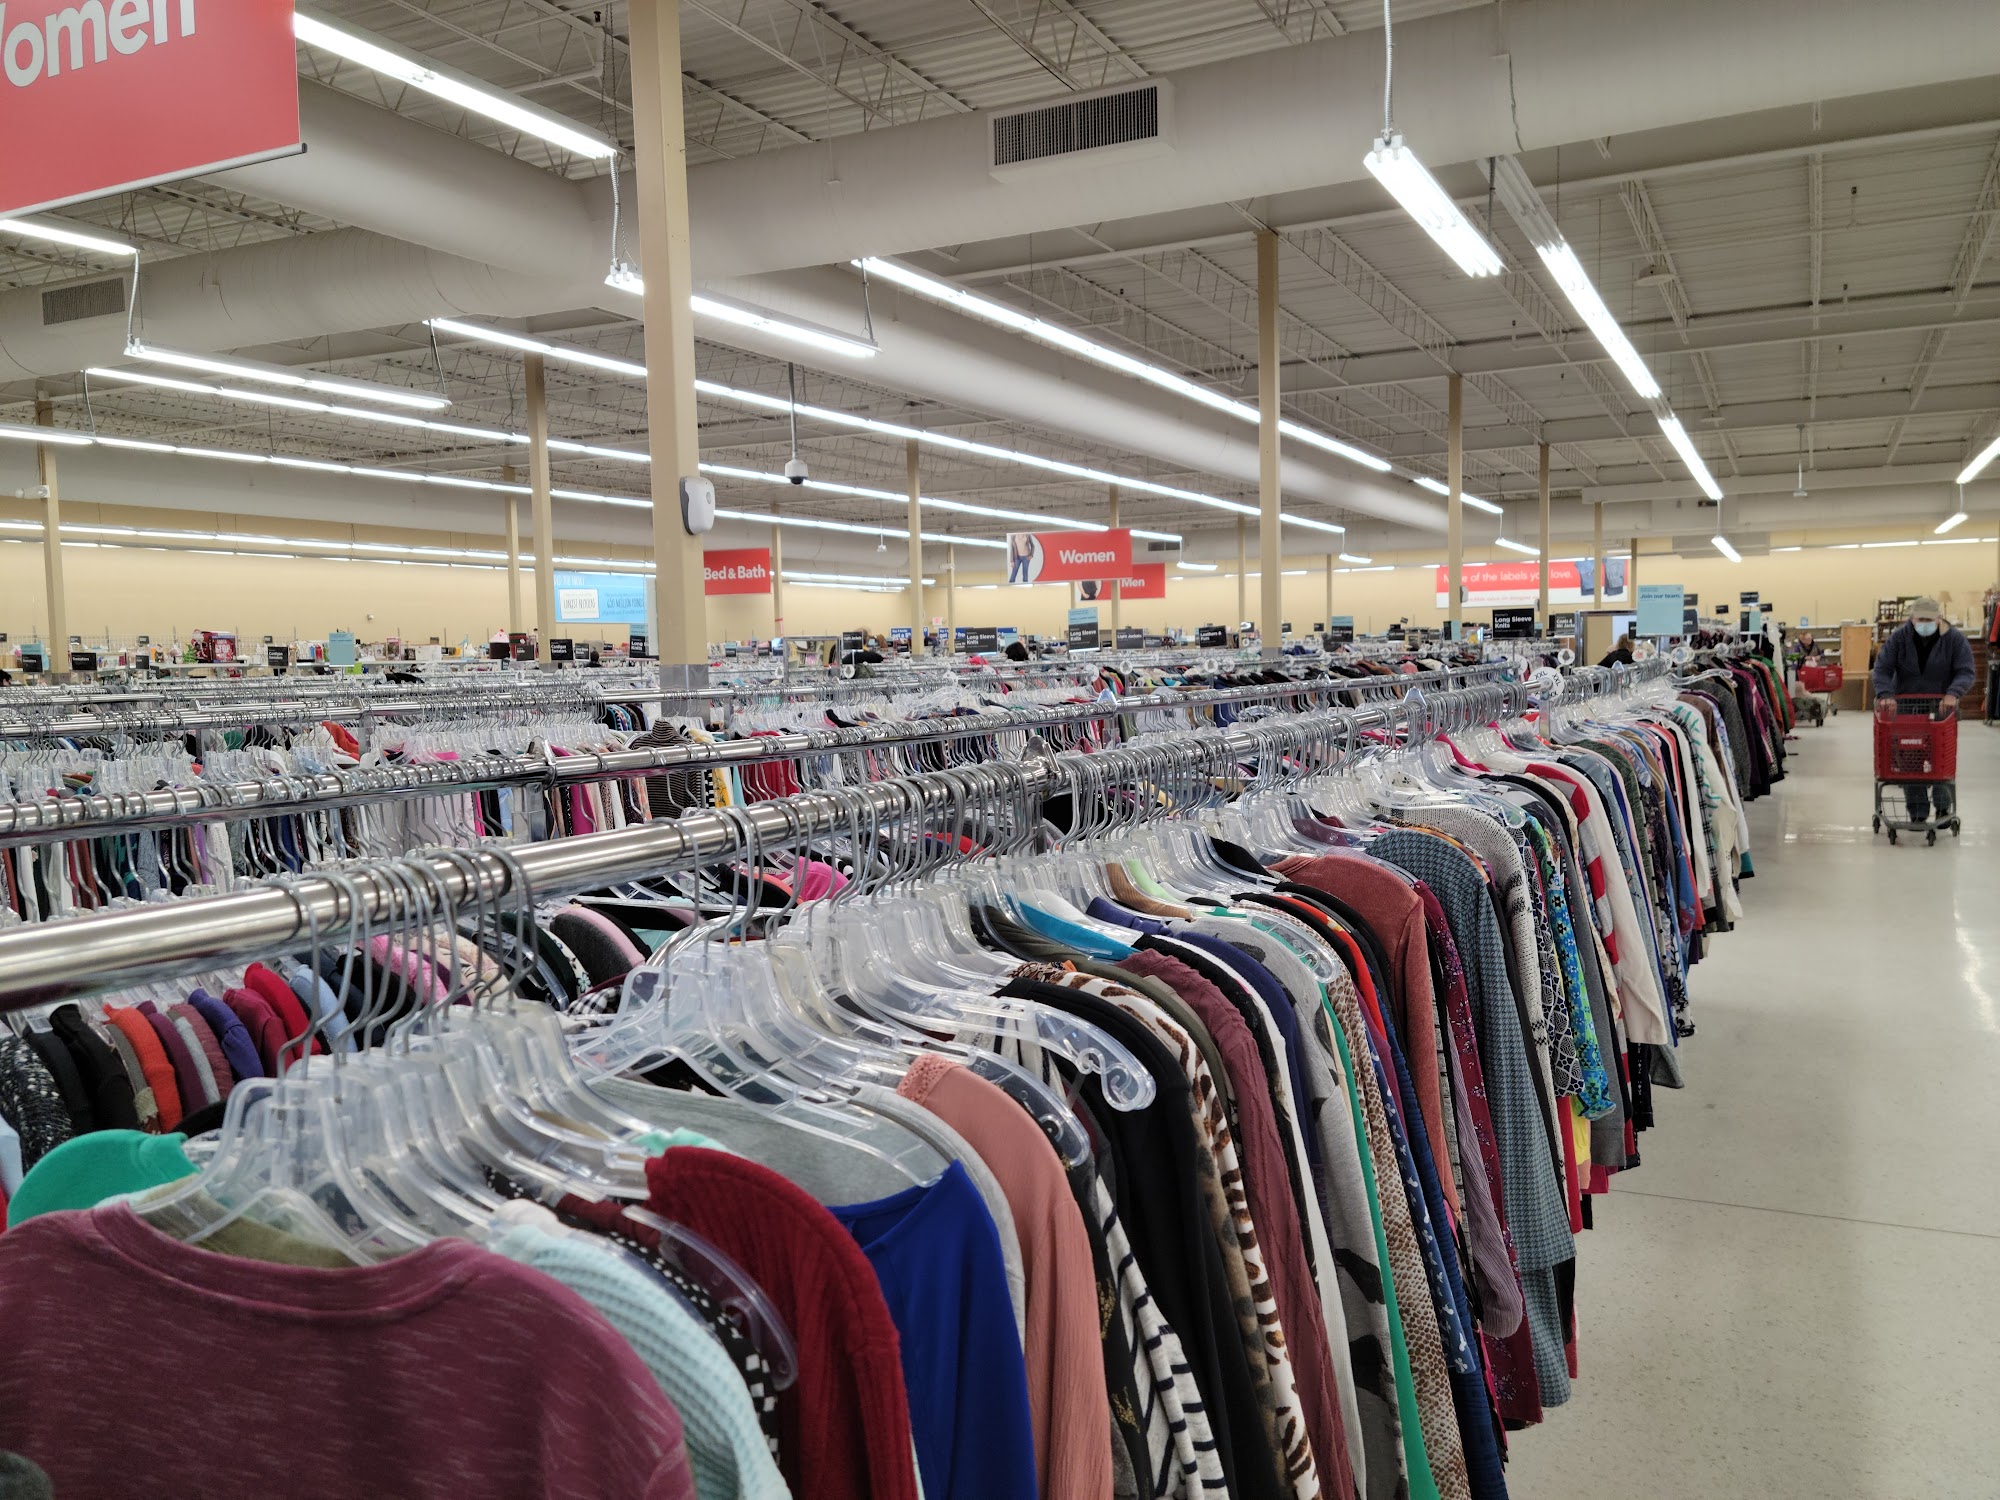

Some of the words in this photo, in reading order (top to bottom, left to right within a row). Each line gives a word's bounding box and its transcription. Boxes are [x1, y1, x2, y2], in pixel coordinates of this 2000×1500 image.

[0, 0, 195, 88] omen
[1059, 550, 1115, 564] Women
[704, 565, 727, 580] Bed
[728, 567, 736, 579] &
[737, 564, 766, 579] Bath
[1470, 573, 1480, 582] of
[1482, 572, 1498, 581] the
[1500, 571, 1528, 580] labels
[1550, 569, 1573, 579] love.
[1121, 577, 1145, 588] Men
[1534, 671, 1548, 679] XXL
